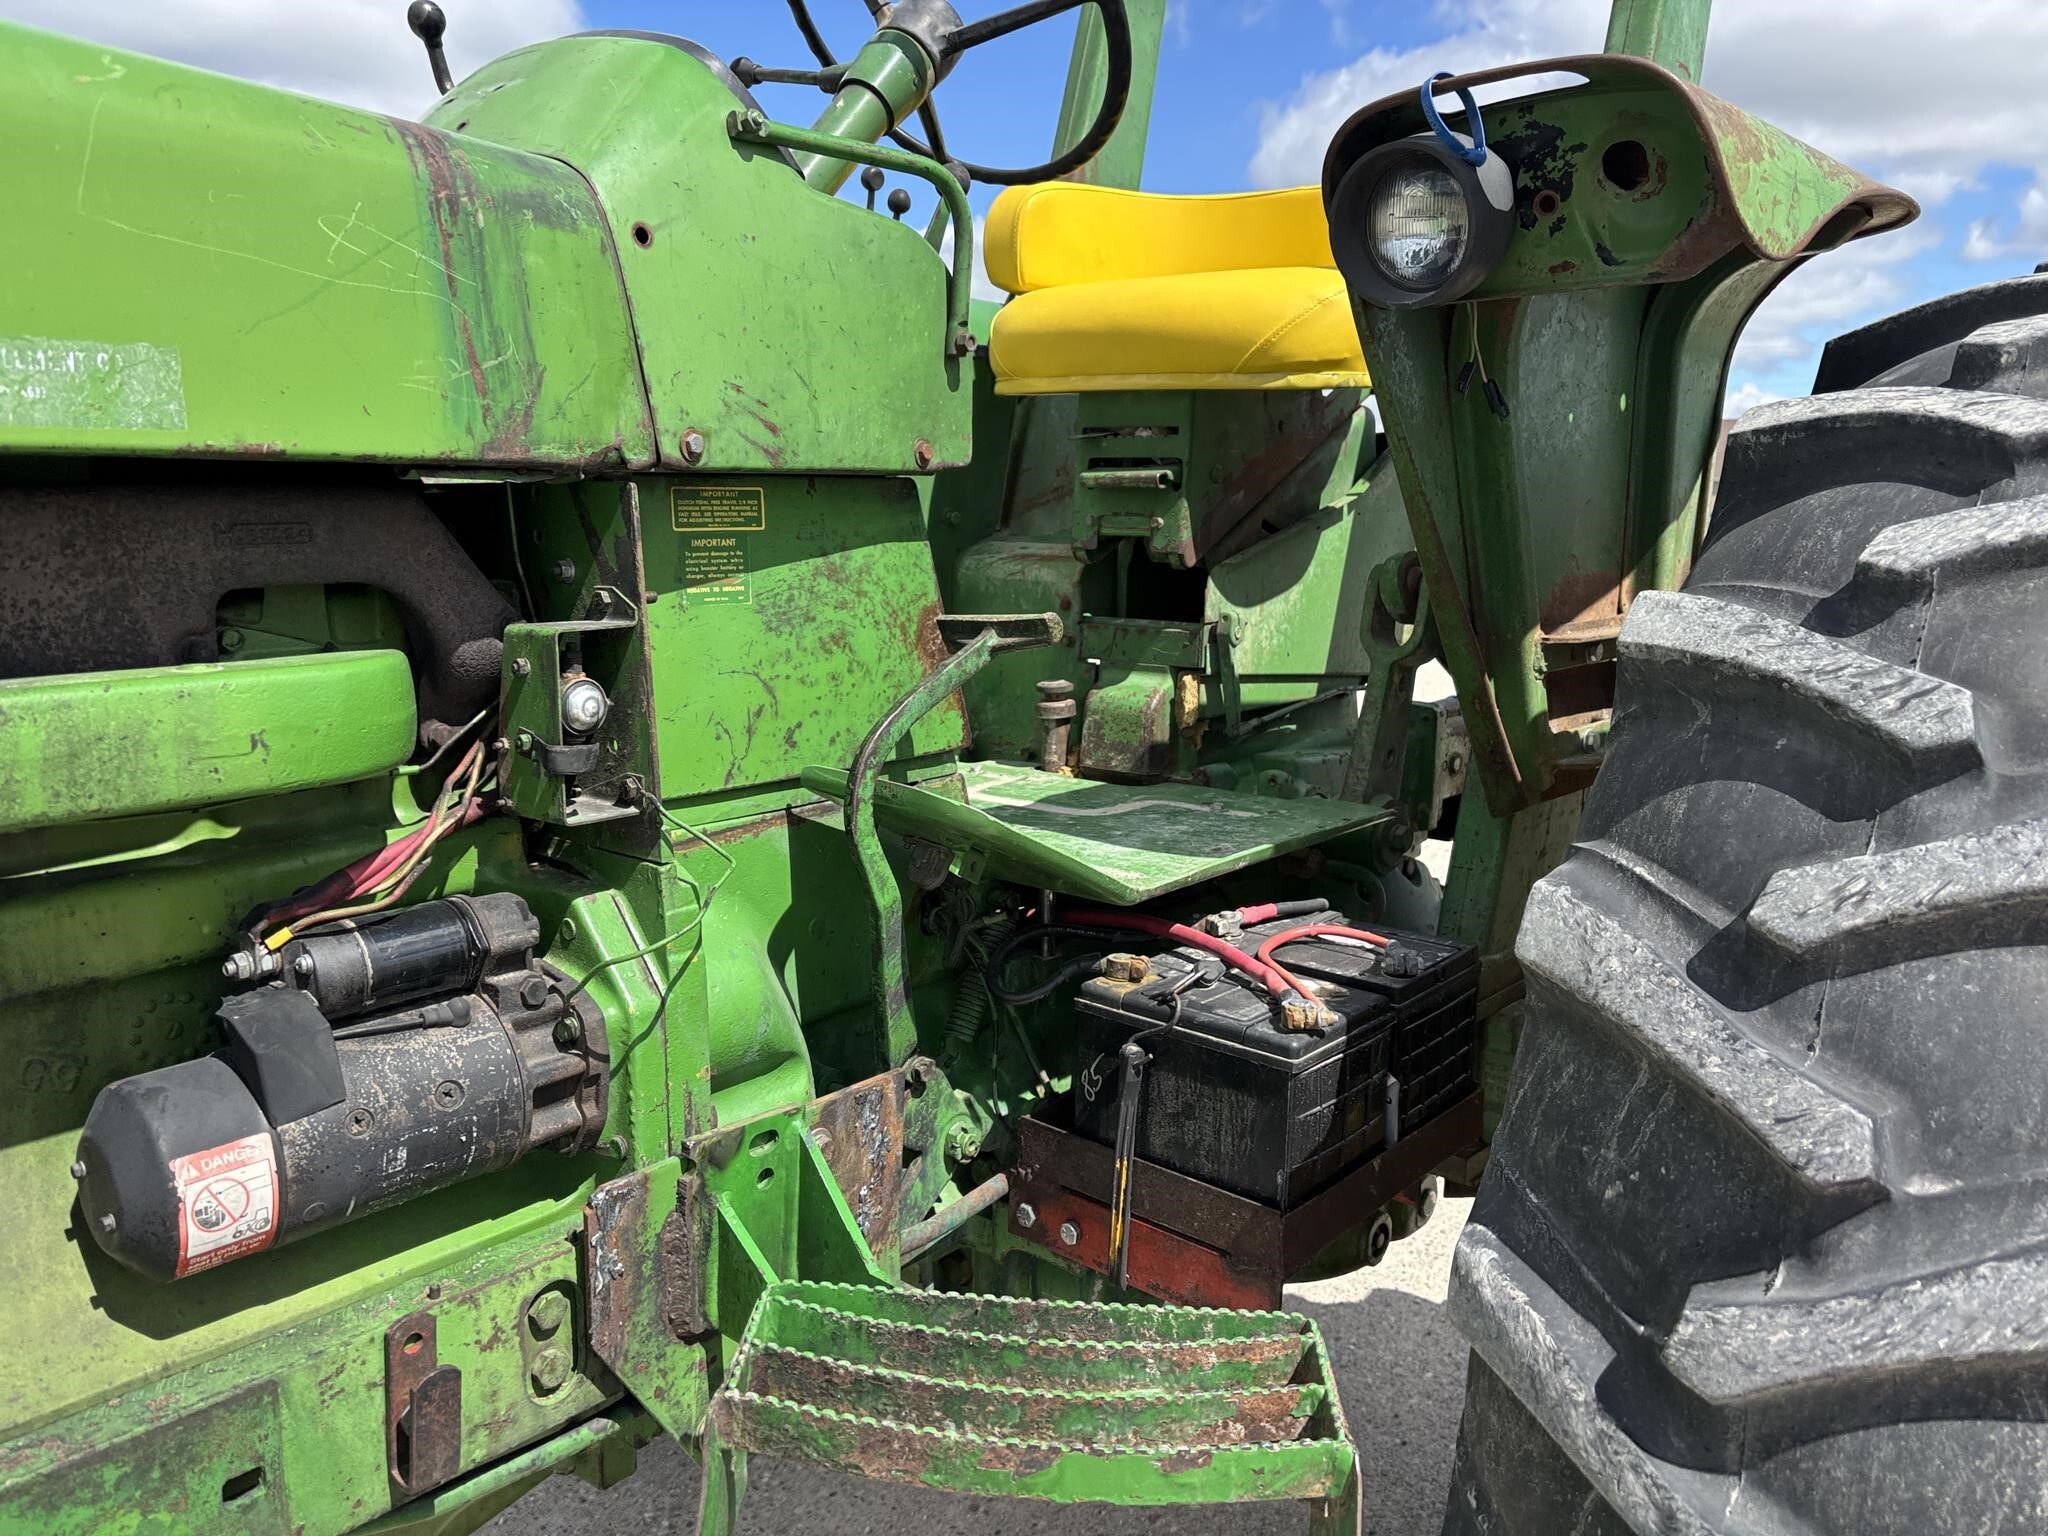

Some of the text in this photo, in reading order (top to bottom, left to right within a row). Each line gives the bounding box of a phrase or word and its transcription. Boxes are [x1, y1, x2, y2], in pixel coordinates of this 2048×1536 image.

[691, 538, 736, 547] IMPORTANT
[1081, 1053, 1105, 1102] 85
[190, 1235, 267, 1265] Start only from
